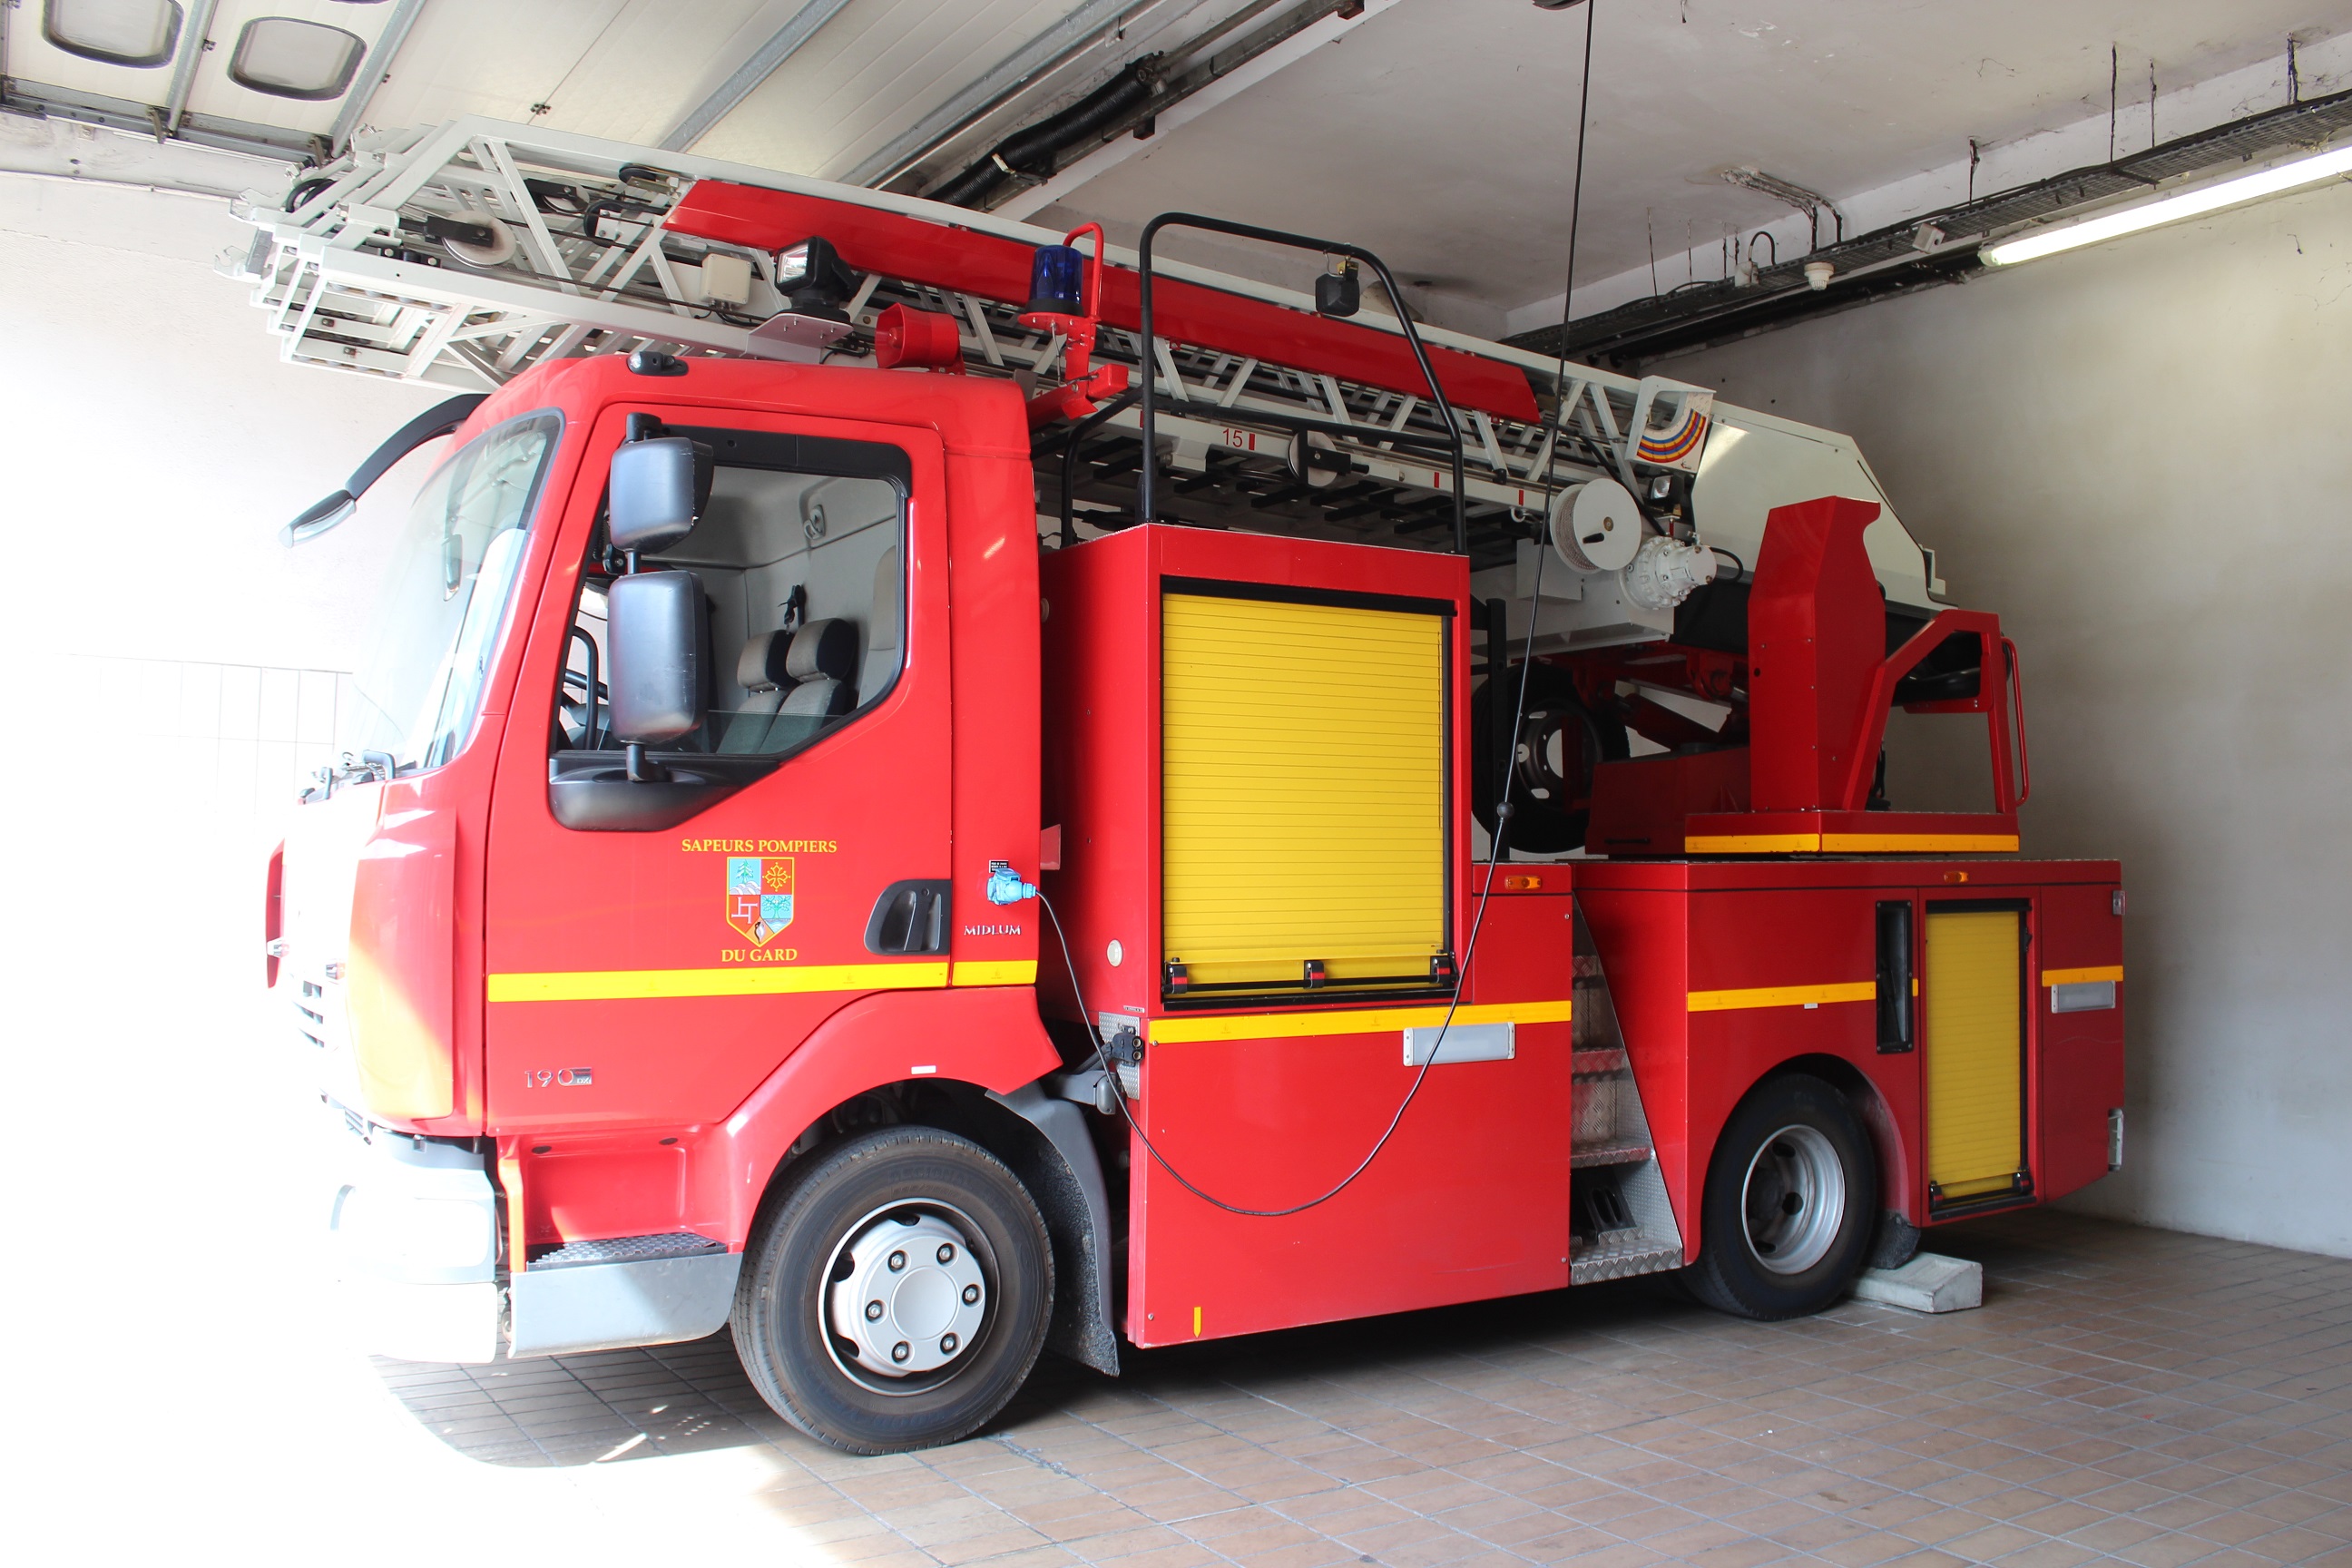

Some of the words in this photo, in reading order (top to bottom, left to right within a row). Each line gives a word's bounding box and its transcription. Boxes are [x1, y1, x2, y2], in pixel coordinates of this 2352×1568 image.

[1222, 427, 1243, 448] 15
[681, 838, 754, 853] SAPEURS
[758, 839, 838, 853] POMPIERS
[964, 925, 1021, 936] MIDLUM
[721, 949, 746, 962] DU
[750, 948, 798, 962] GARD
[524, 1068, 573, 1088] 190
